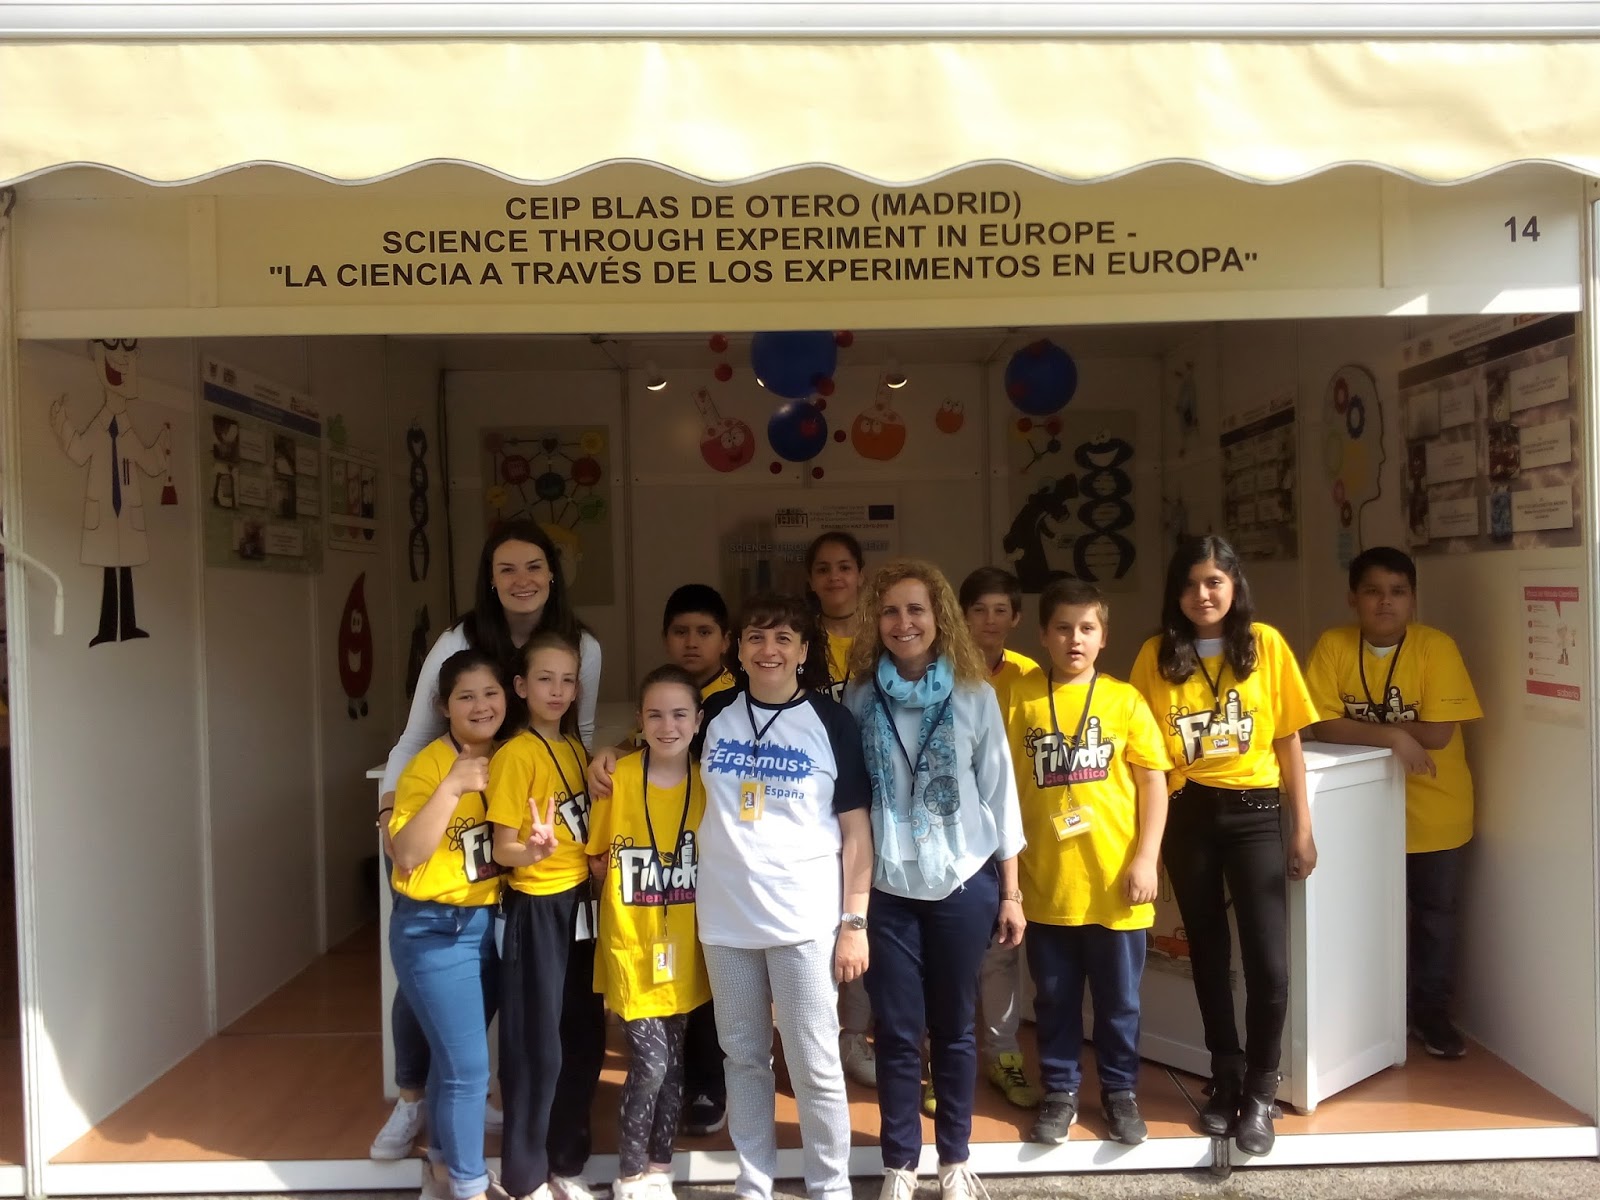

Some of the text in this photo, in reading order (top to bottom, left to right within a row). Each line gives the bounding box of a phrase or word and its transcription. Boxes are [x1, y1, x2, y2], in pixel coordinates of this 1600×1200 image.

[505, 190, 1022, 223] CEIP BLAS DE OTERO (MADRID)
[382, 229, 529, 255] SCIENCE
[538, 228, 704, 253] THROUGH
[716, 225, 927, 251] EXPERIMENT
[937, 224, 967, 248] IN
[979, 221, 1116, 247] EUROPE
[1504, 215, 1541, 243] 14
[269, 246, 1258, 288] "LA CIENCIA A TRAVÉS DE LOS EXPERIMENTOS EN EUROPA"
[729, 543, 812, 552] SCIENCE THROU
[712, 747, 811, 773] Erasmus+
[764, 785, 805, 800] España
